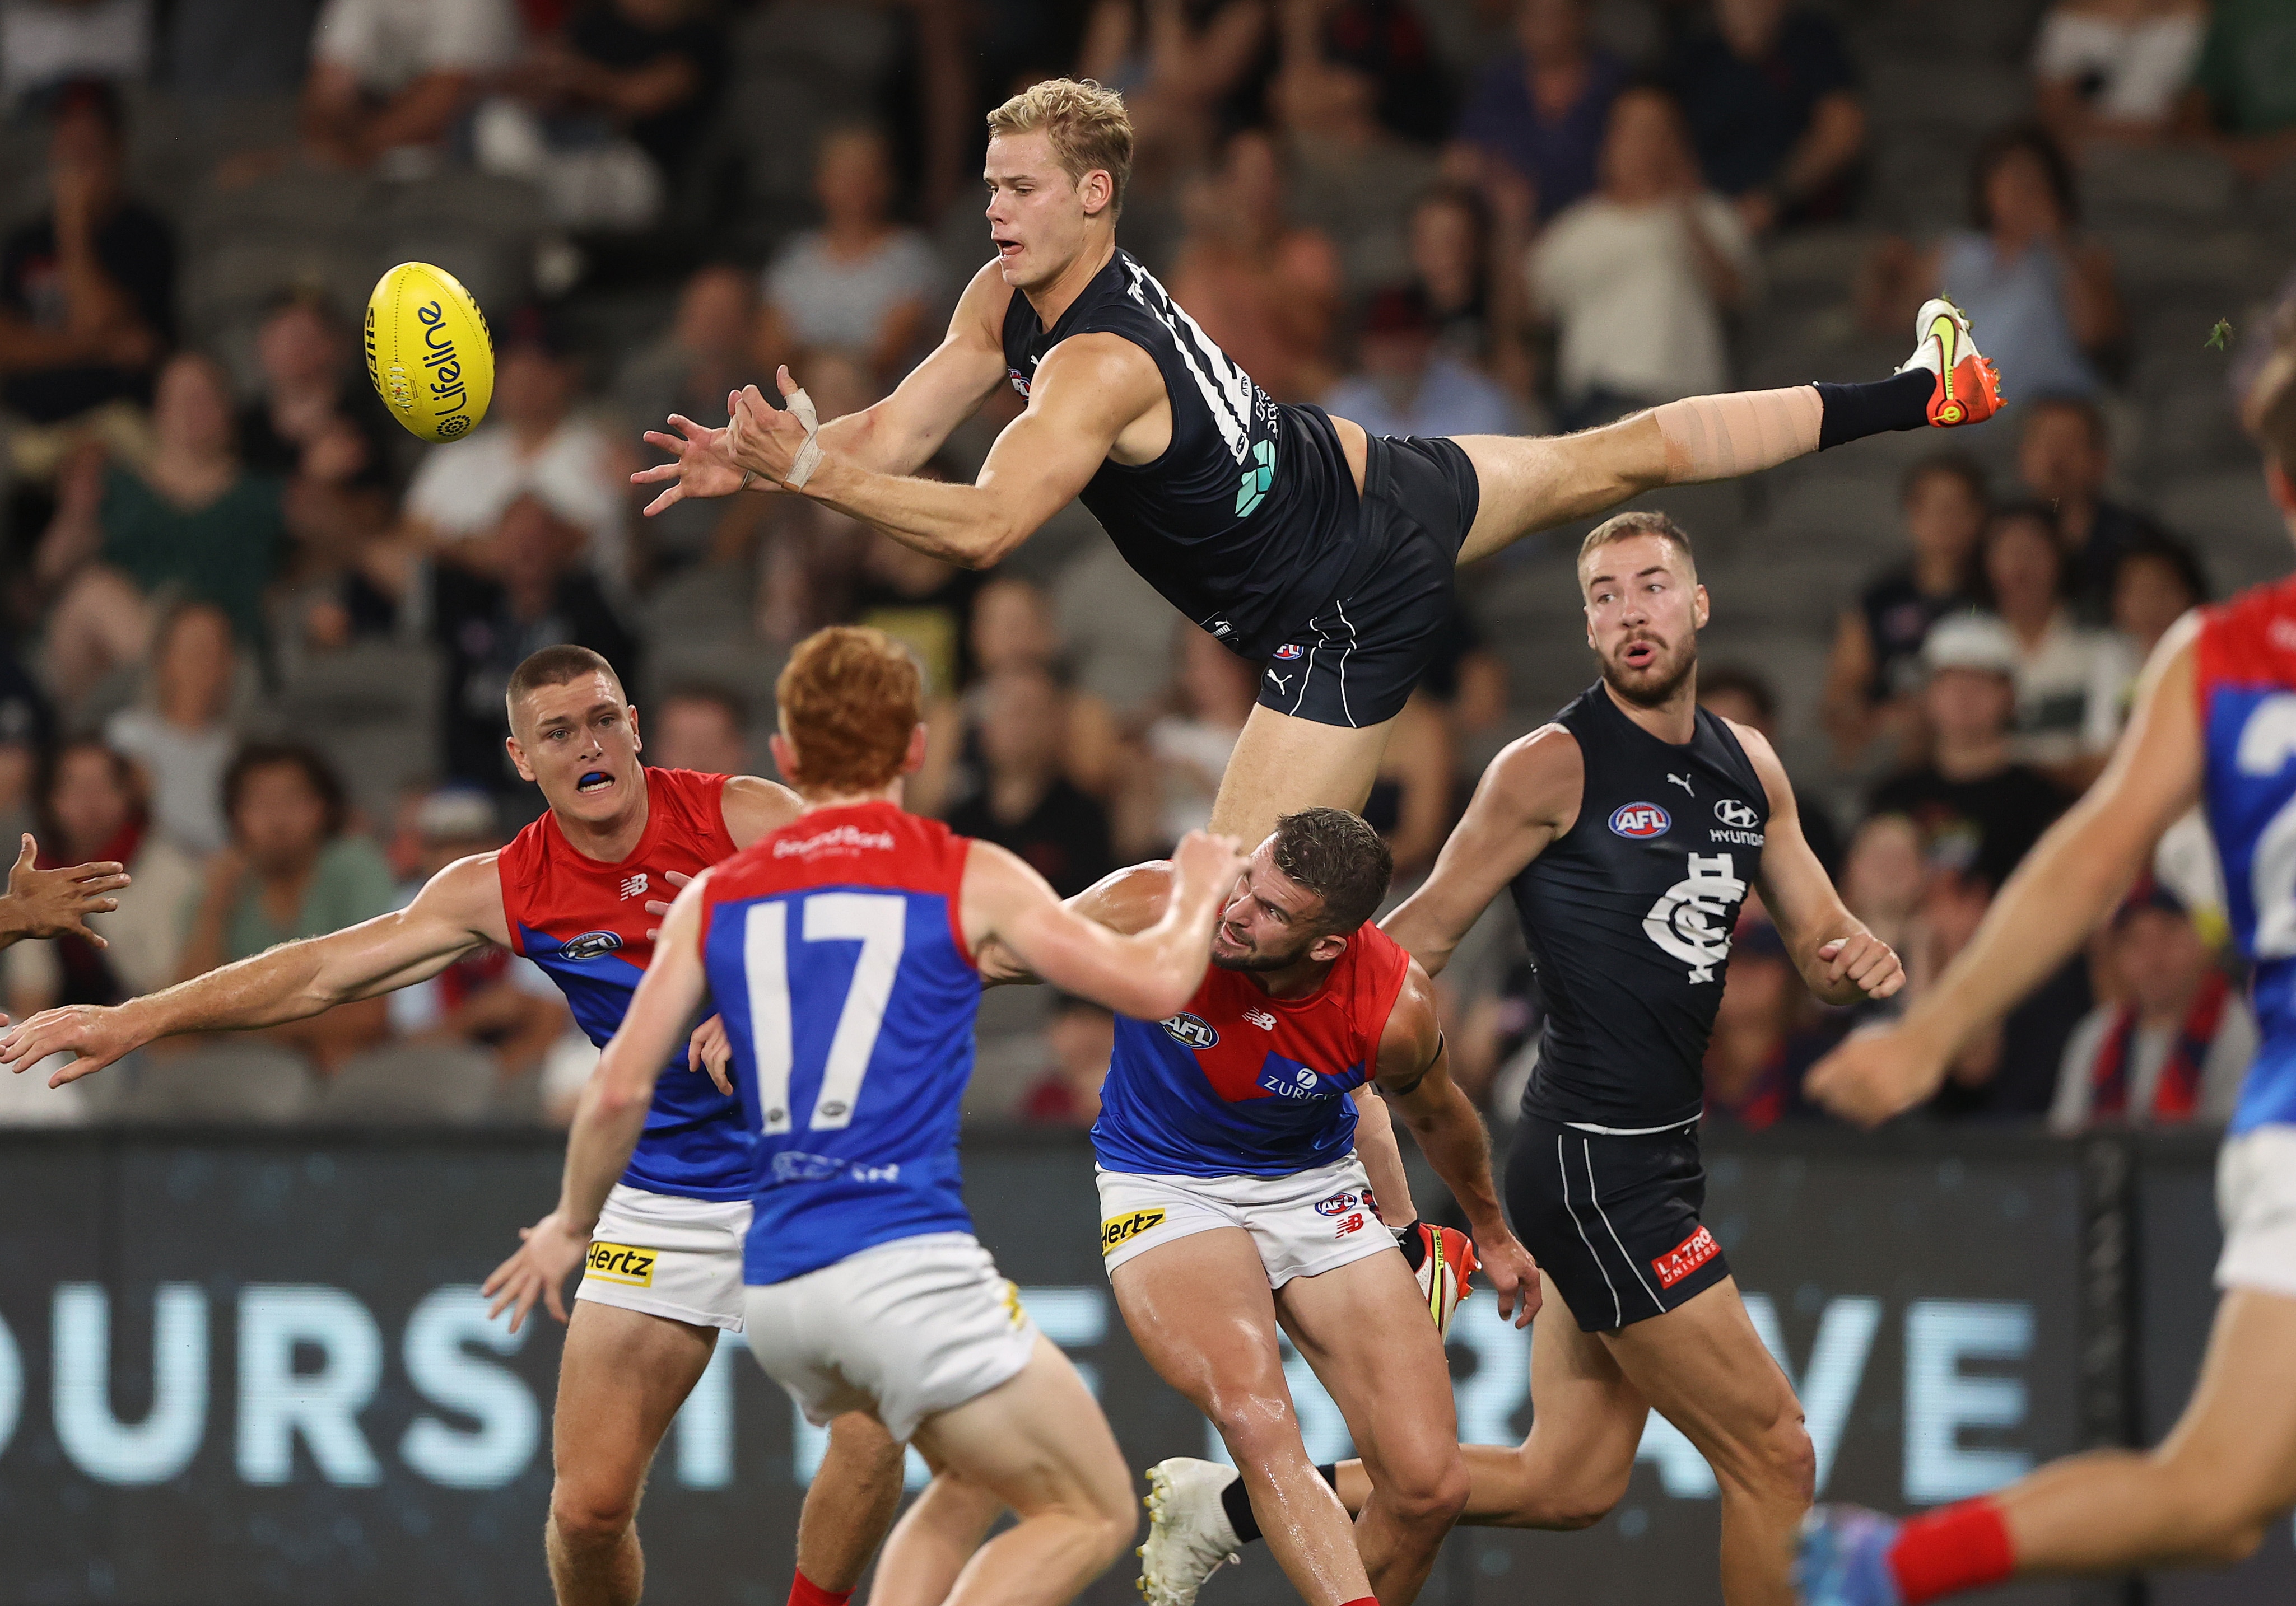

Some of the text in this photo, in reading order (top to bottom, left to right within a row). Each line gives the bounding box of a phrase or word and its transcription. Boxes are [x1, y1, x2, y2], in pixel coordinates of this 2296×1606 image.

[418, 301, 467, 416] Lifeline
[1212, 624, 1231, 637] UMA
[1617, 810, 1667, 831] AFL
[743, 893, 906, 1135] 17
[1159, 1016, 1210, 1047] AFL
[1321, 1196, 1355, 1214] AFL
[1102, 1213, 1163, 1248] Hertz
[589, 1243, 653, 1276] Hertz
[1657, 1227, 1712, 1276] LA TRO
[0, 1280, 542, 1493] URS
